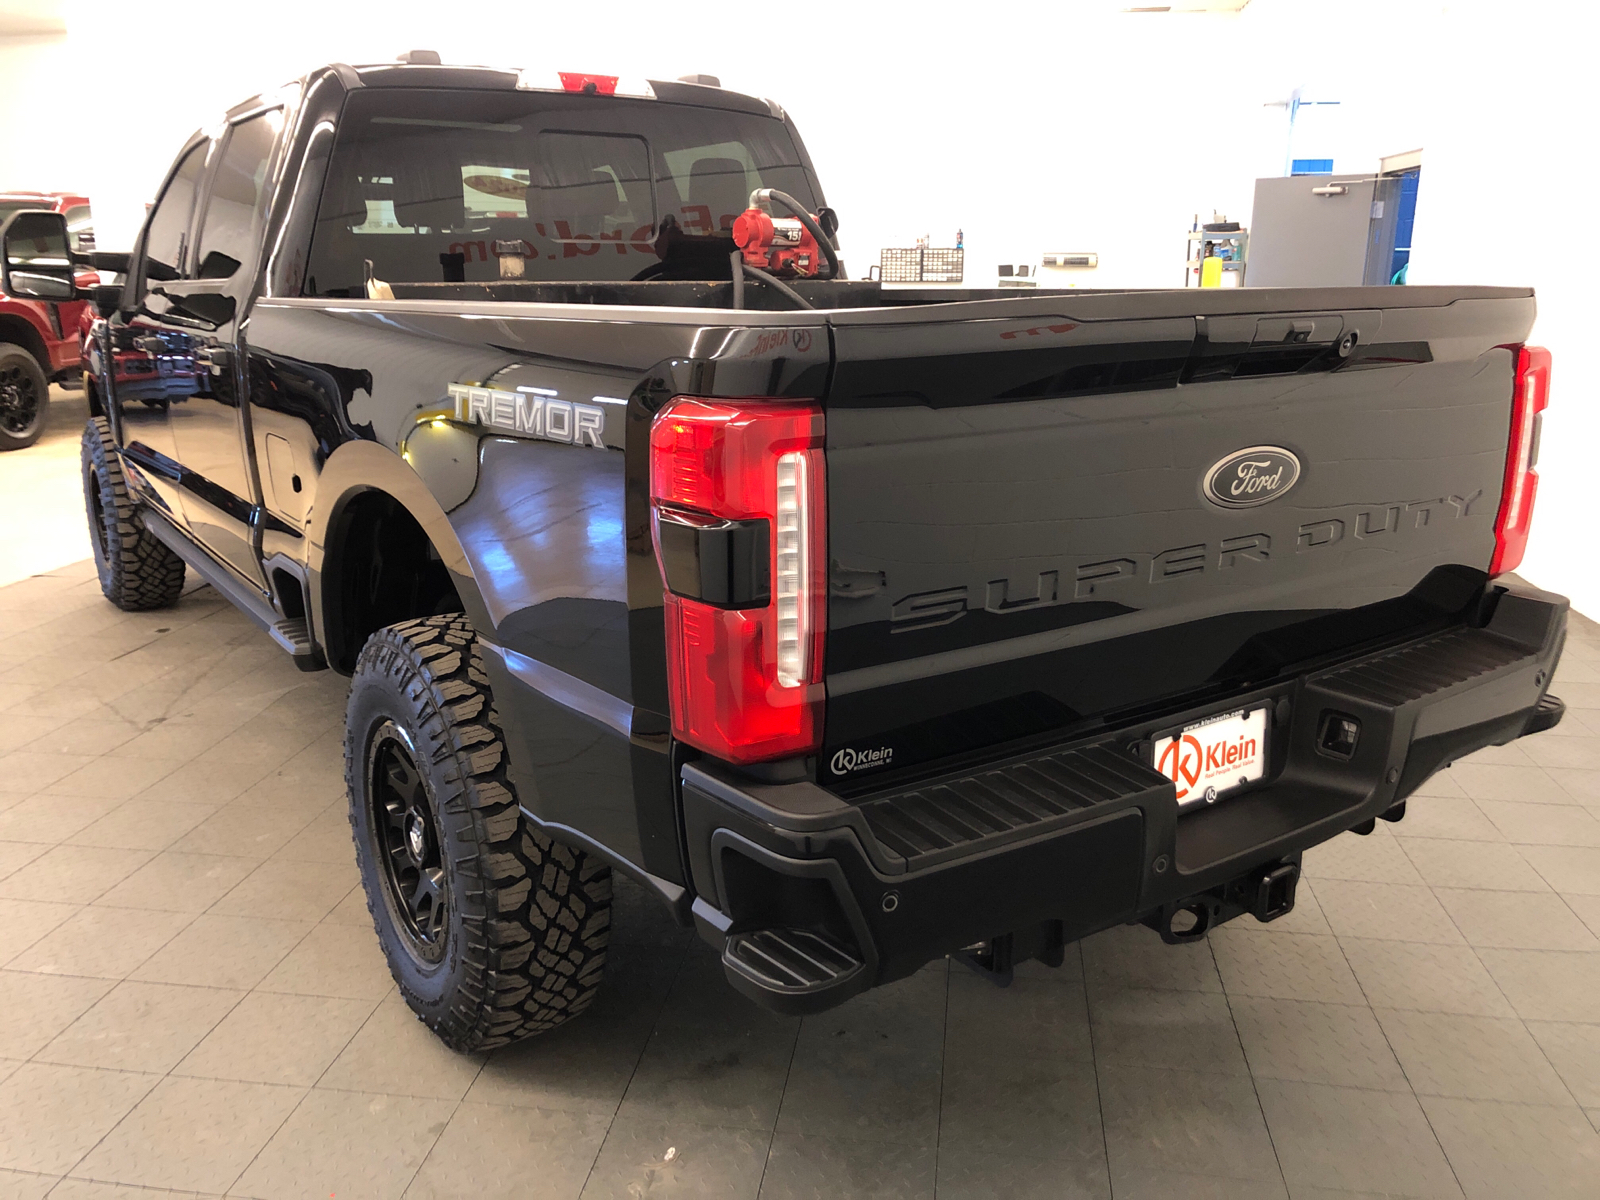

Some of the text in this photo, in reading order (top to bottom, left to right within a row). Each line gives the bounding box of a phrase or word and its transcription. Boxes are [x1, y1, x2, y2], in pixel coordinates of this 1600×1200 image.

[447, 382, 608, 451] TREMOR
[1230, 461, 1283, 496] Ford
[890, 489, 1483, 634] SUPER DUTY
[1183, 709, 1245, 732] www.kleinauto.com
[857, 746, 893, 764] Klein
[1205, 735, 1256, 771] Klein
